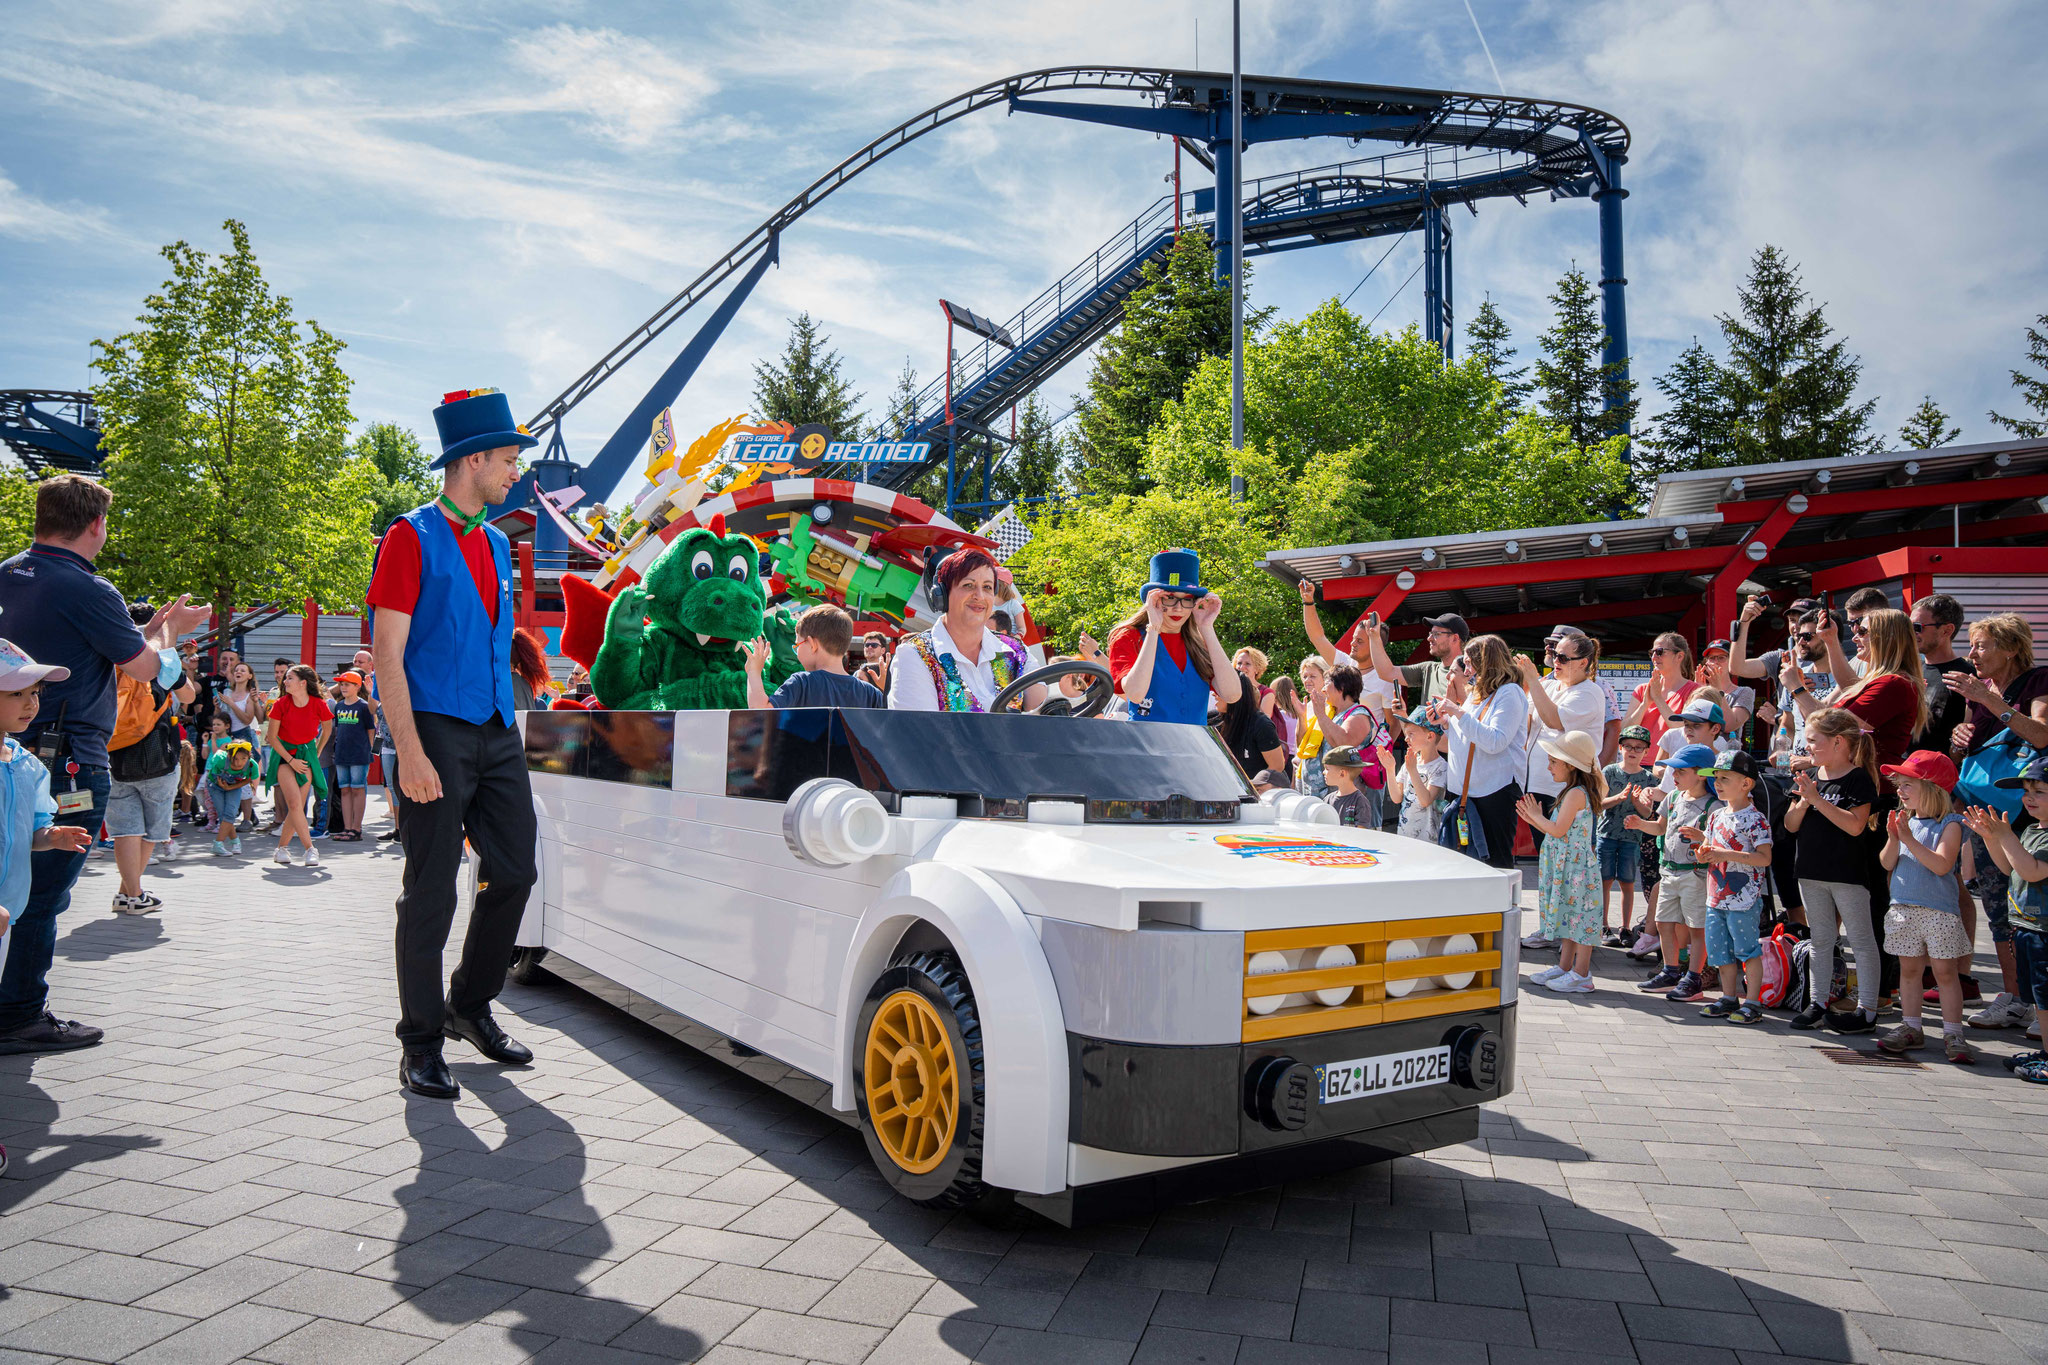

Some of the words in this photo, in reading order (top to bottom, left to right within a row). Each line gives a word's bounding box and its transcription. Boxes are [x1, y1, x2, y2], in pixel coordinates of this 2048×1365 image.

[730, 443, 796, 462] LEGO
[824, 443, 929, 461] RENNEN
[1327, 1068, 1352, 1097] GZ
[1363, 1063, 1387, 1092] LL
[1392, 1052, 1448, 1086] 2022E
[1480, 1039, 1498, 1085] LEGO
[1286, 1073, 1308, 1124] LEGO
